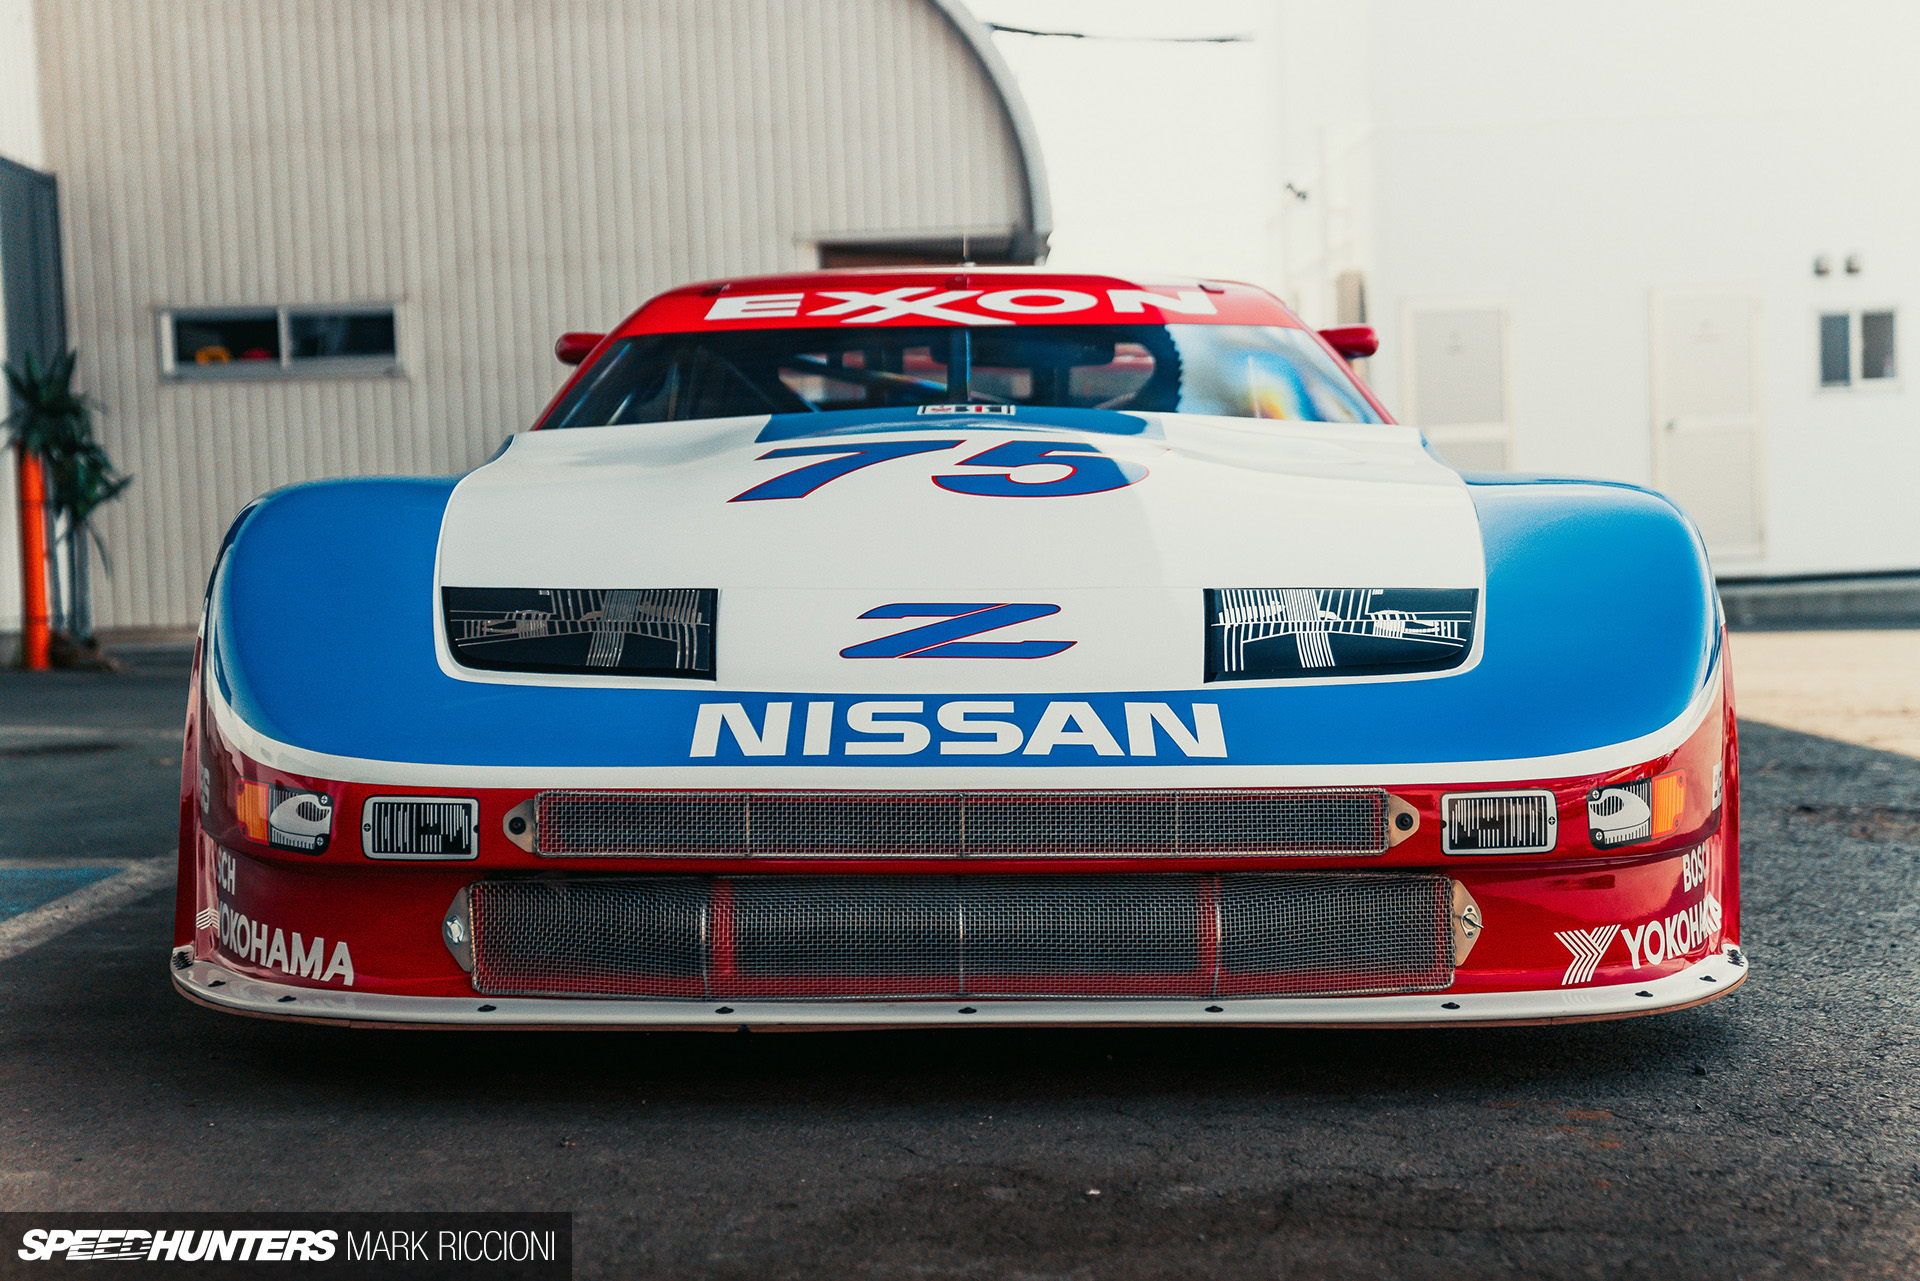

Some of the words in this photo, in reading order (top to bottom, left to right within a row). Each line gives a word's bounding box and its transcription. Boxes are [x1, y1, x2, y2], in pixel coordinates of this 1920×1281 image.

[704, 287, 1217, 325] EXXON
[726, 440, 1150, 503] 75
[839, 602, 1077, 659] Z
[690, 701, 1228, 758] NISSAN
